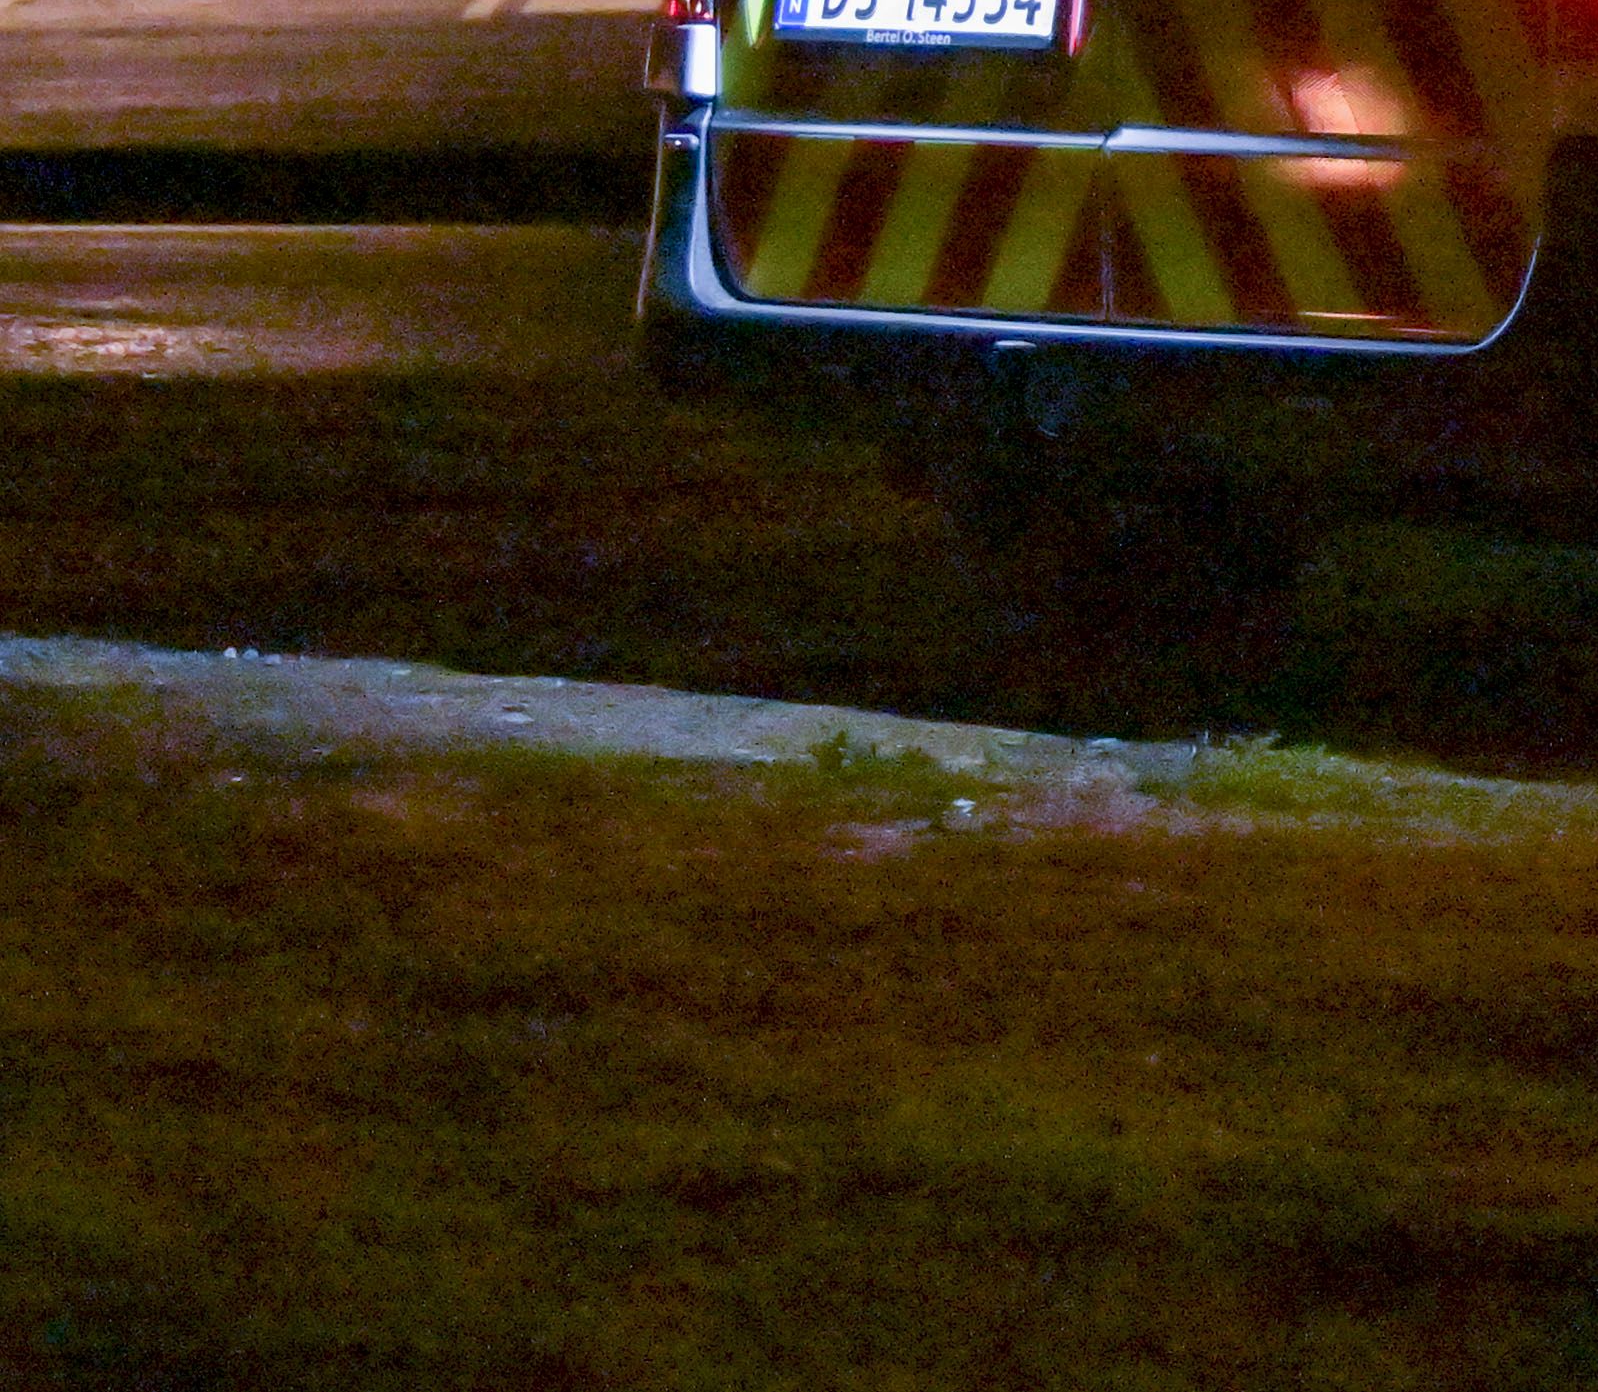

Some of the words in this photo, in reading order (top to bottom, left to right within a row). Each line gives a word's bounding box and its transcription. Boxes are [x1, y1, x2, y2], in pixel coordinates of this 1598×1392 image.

[866, 29, 900, 43] Bertel
[902, 29, 916, 44] O.
[918, 31, 951, 46] Steen
